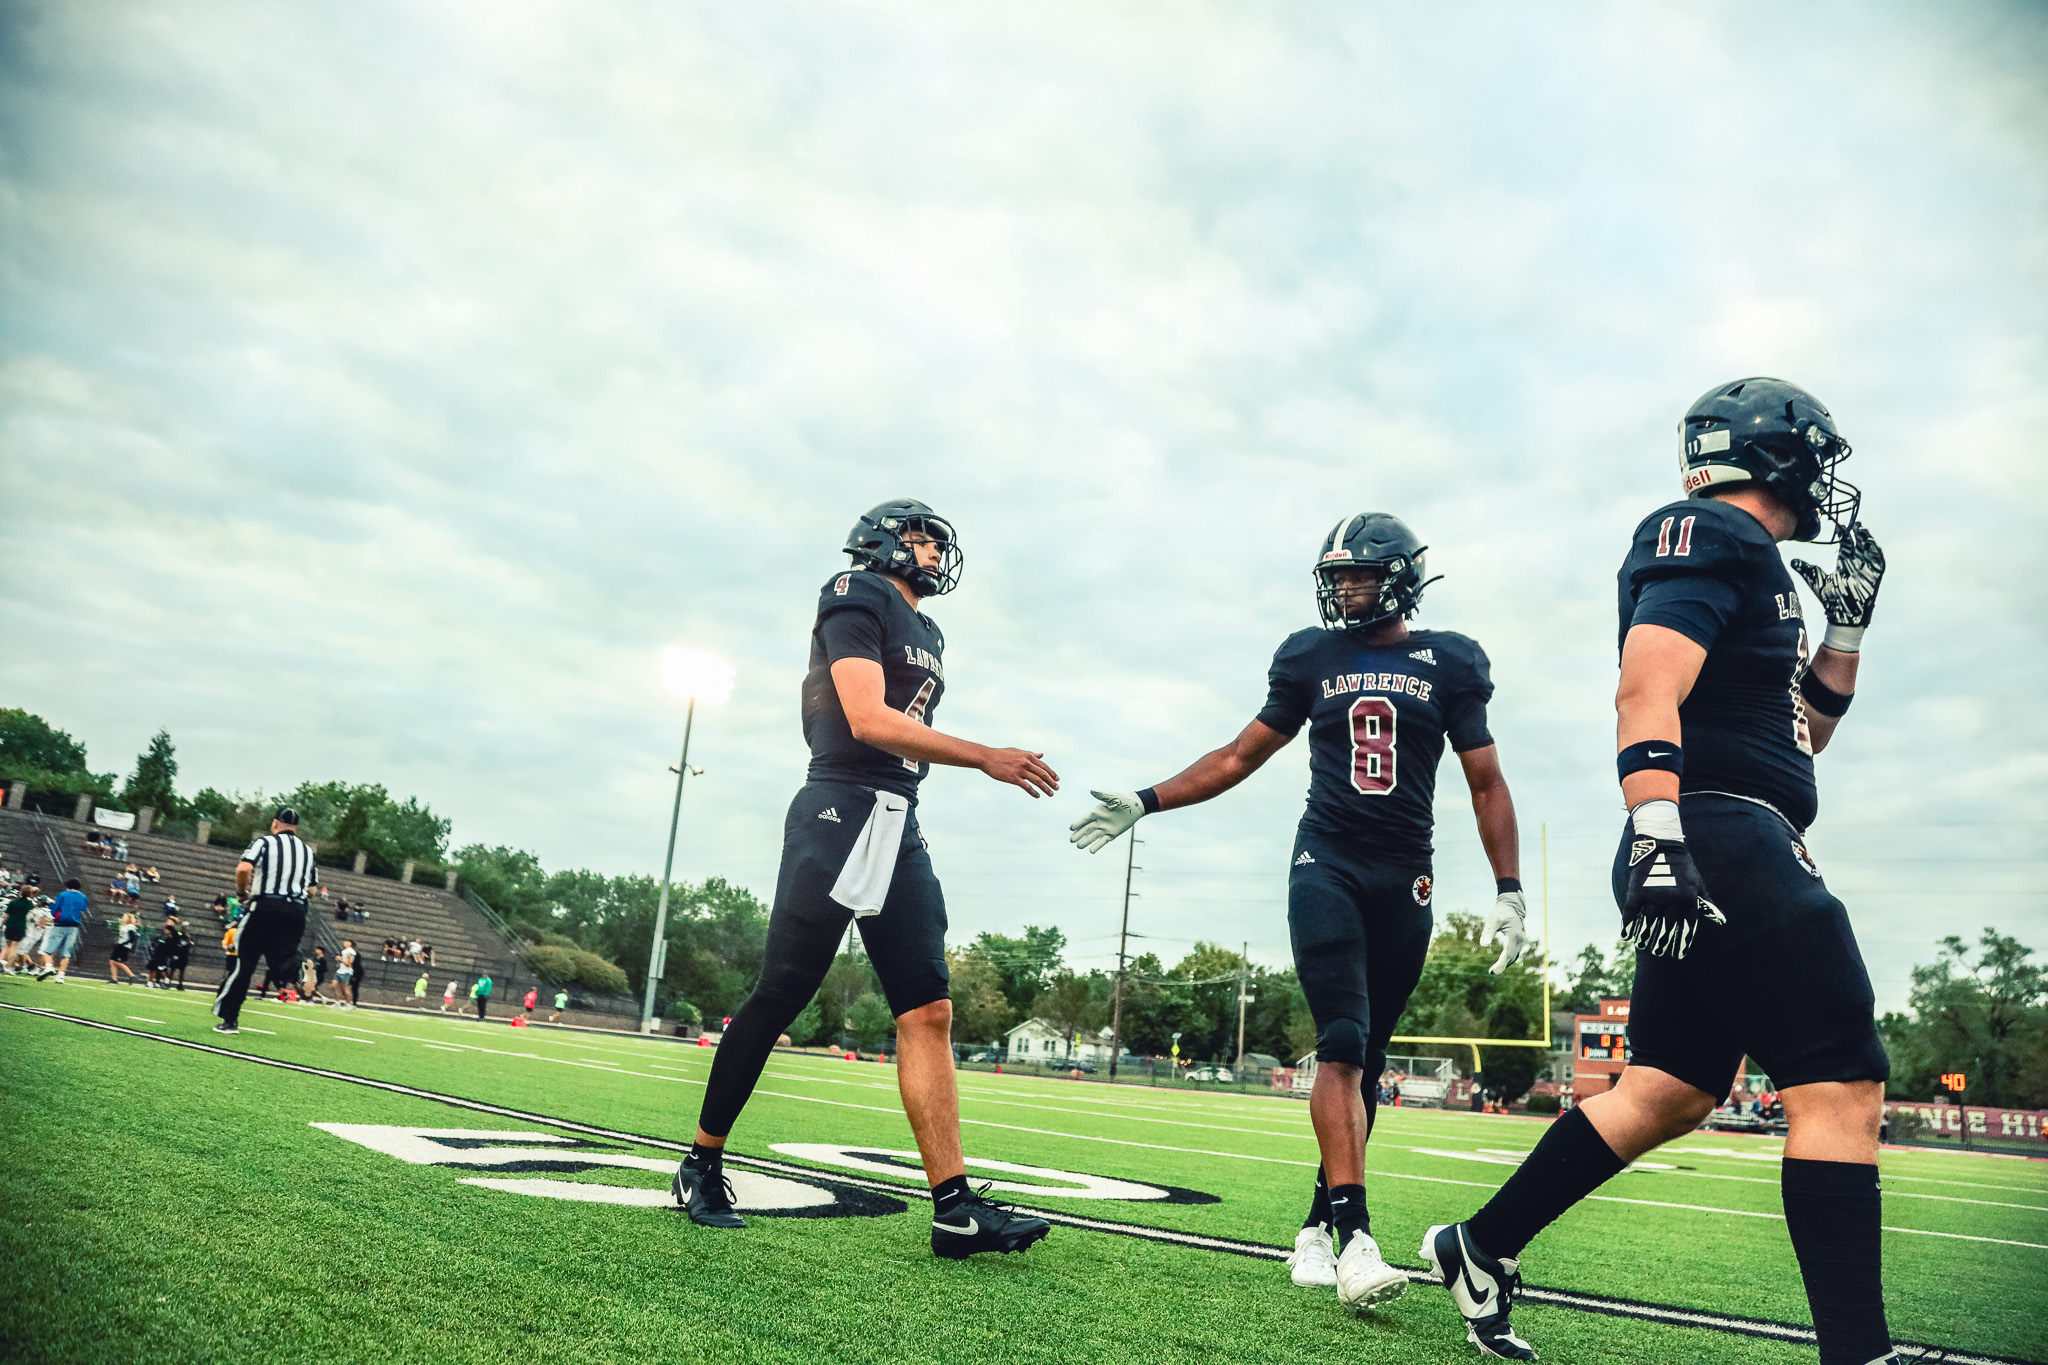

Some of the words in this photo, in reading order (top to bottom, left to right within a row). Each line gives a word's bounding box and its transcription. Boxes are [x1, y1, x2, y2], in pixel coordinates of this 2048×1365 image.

[1687, 439, 1698, 455] 11
[1683, 469, 1712, 493] dell
[1655, 515, 1696, 557] 11
[834, 573, 852, 596] 4
[1408, 651, 1437, 666] adidas
[1321, 672, 1432, 702] LAWRENCE
[1348, 696, 1398, 796] 8
[1941, 1073, 1966, 1091] 40
